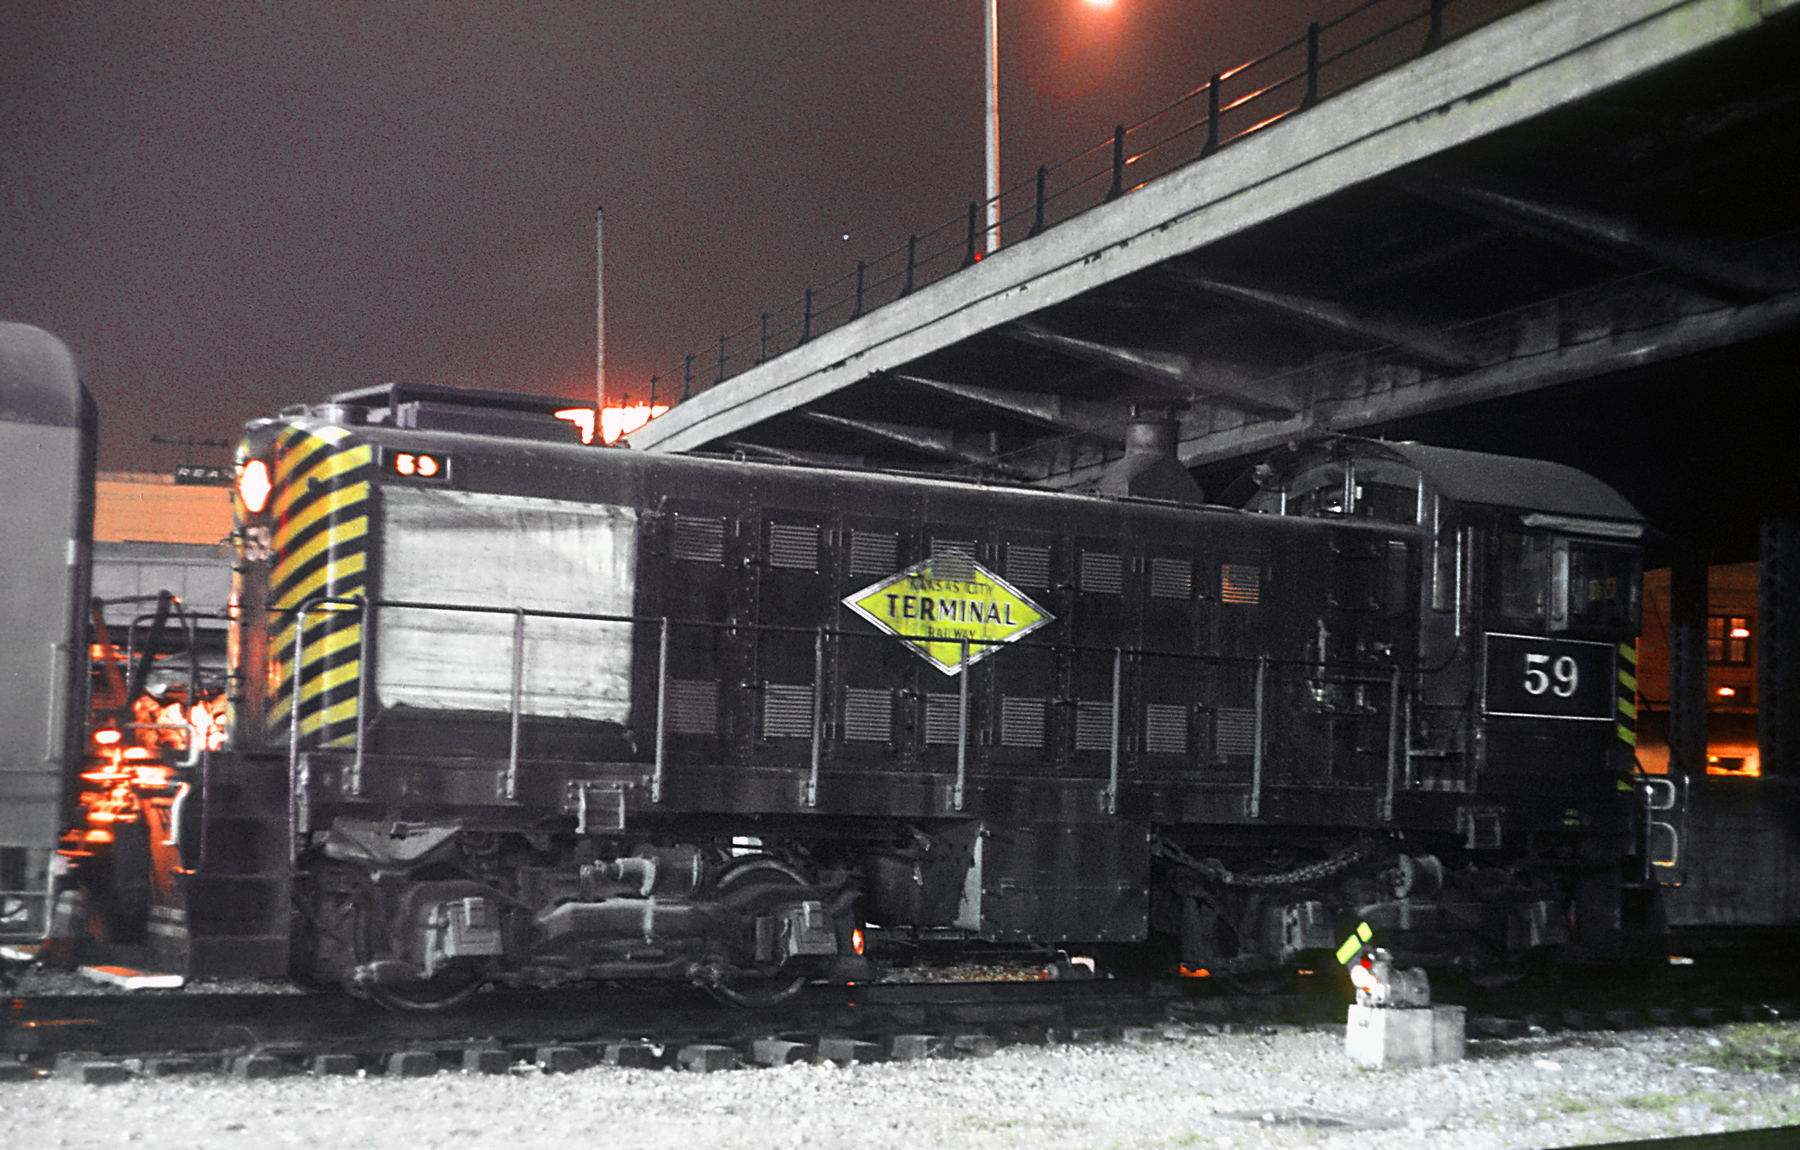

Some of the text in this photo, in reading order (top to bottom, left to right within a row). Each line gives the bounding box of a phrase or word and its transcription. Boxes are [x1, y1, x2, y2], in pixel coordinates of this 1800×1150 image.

[395, 453, 439, 477] 59
[909, 577, 993, 595] KANSAS CITY
[886, 593, 1017, 626] TERMINAL
[927, 625, 976, 639] RAILWAY
[1524, 653, 1578, 697] 59
